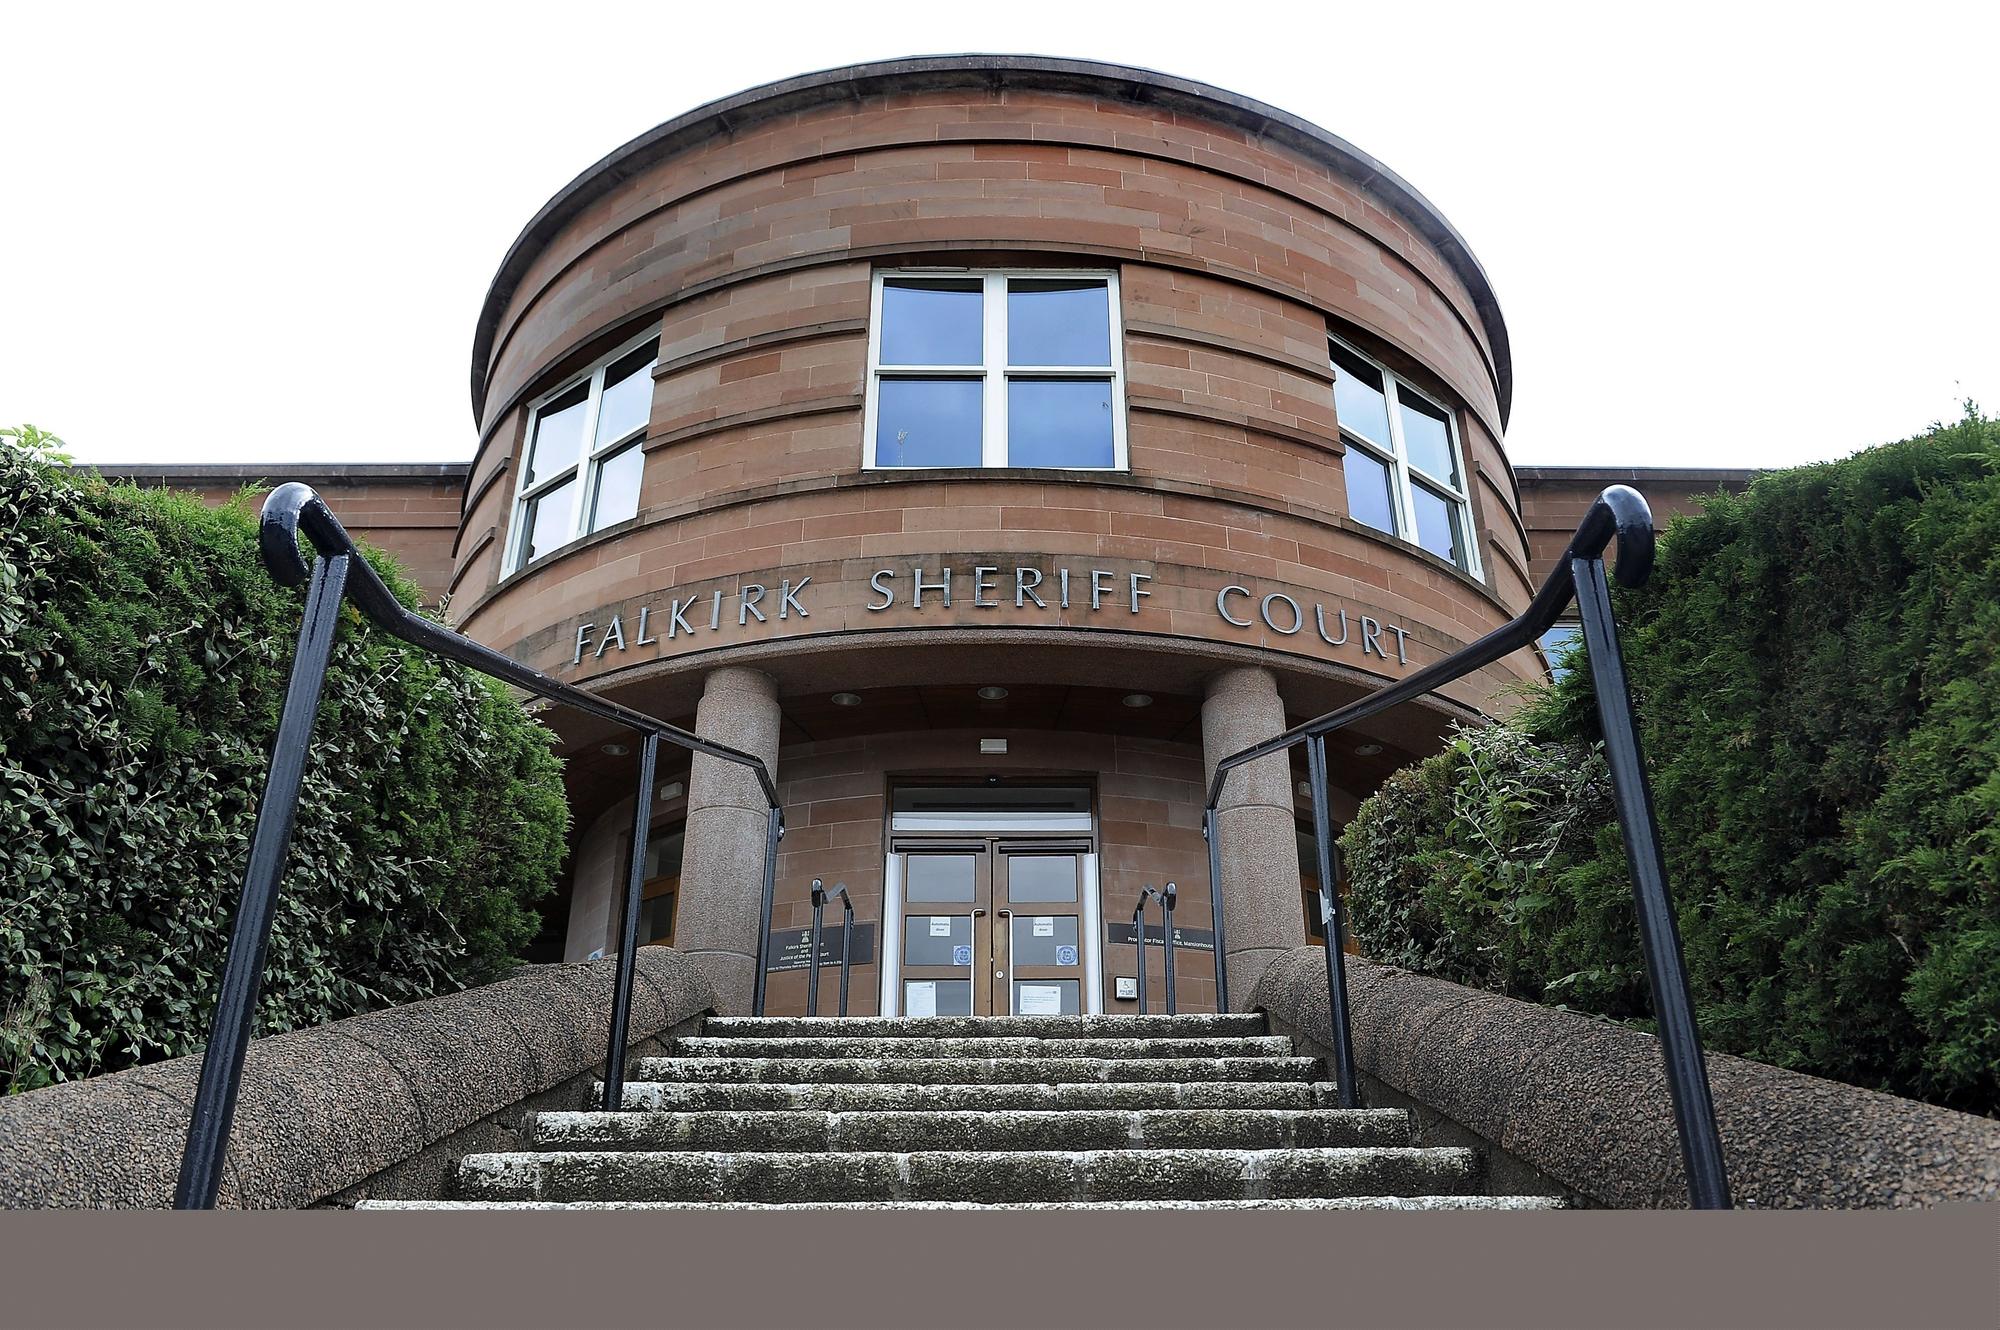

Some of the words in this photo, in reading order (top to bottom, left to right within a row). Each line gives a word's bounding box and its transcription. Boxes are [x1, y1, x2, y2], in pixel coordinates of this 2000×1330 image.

[573, 575, 812, 666] FALKIRK
[866, 566, 1153, 614] SHERIFF
[1215, 584, 1411, 666] COURT
